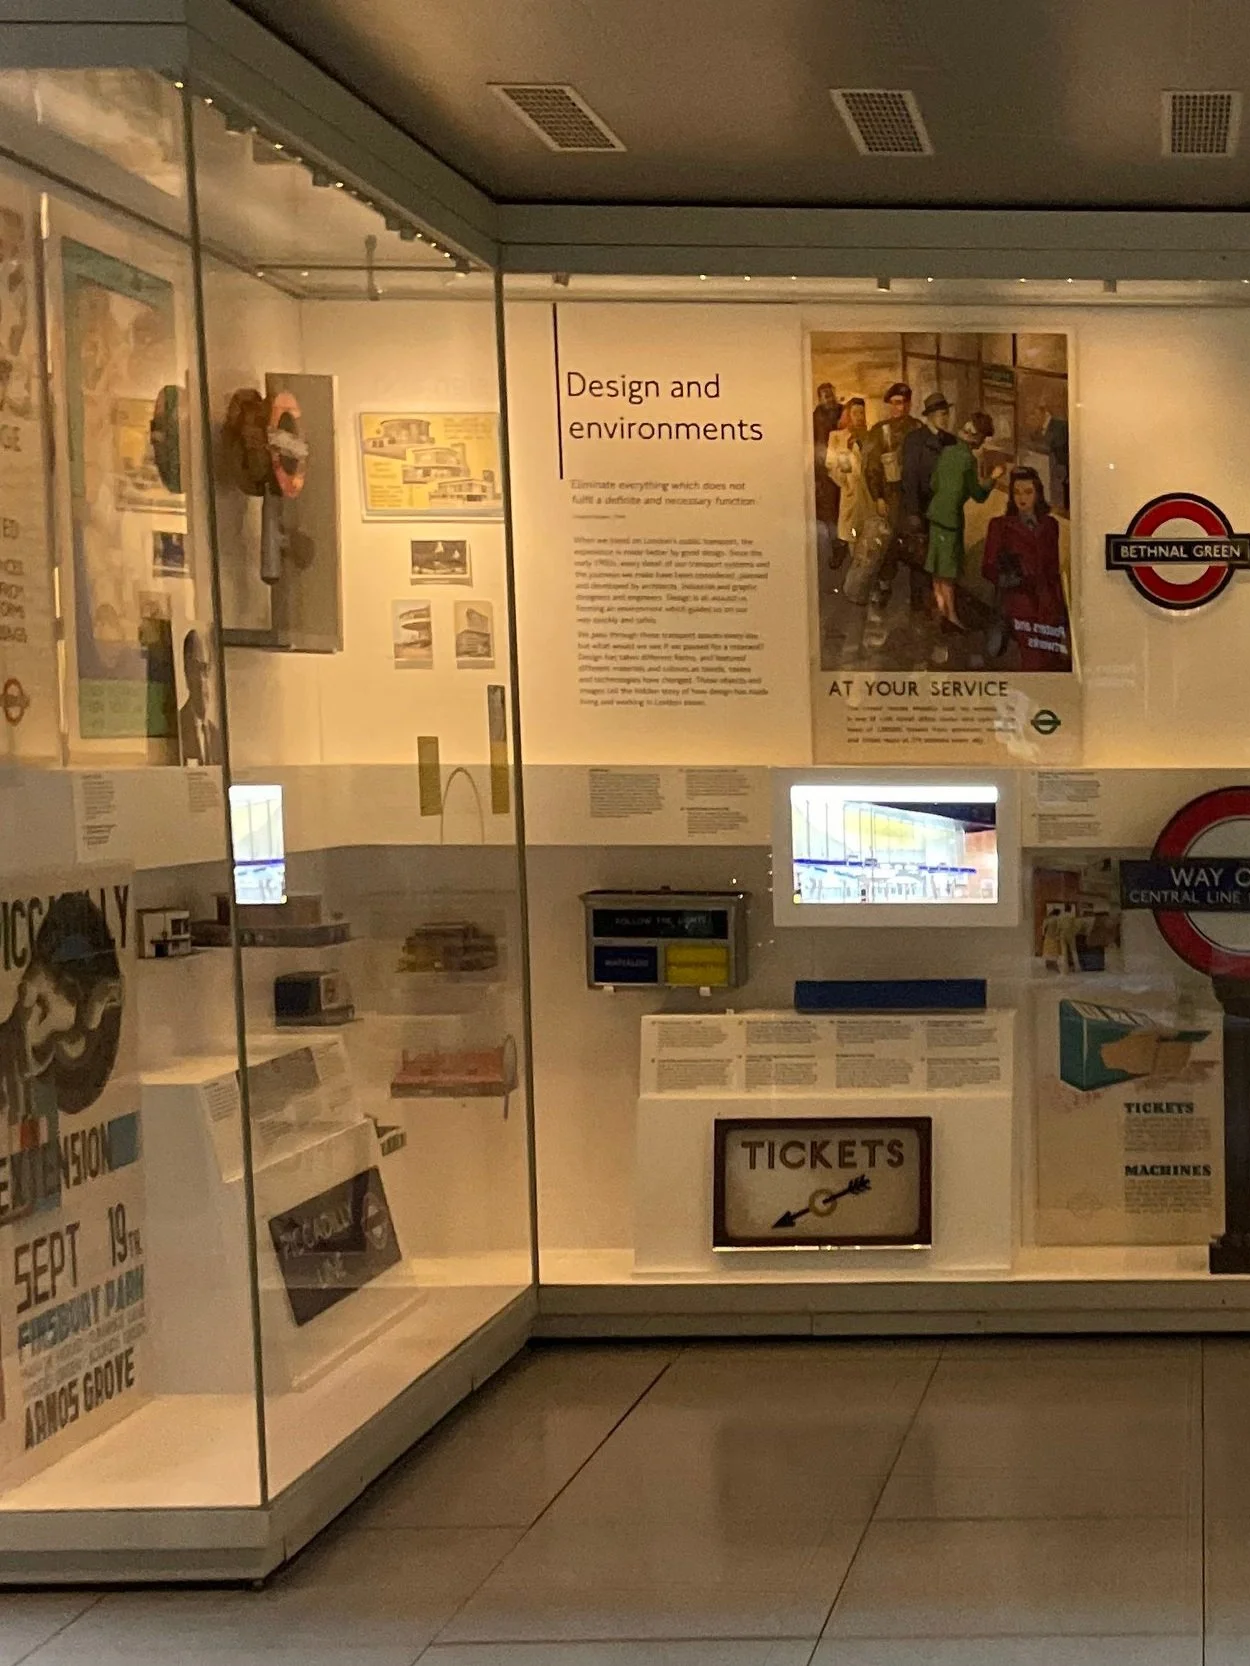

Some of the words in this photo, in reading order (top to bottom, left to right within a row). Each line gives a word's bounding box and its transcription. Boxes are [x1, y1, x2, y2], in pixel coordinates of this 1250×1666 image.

[566, 371, 660, 405] Design
[670, 374, 720, 398] and
[568, 417, 763, 441] environments
[1120, 545, 1188, 559] BETHNAL
[1193, 545, 1241, 558] GREEN
[829, 682, 852, 697] AT
[865, 681, 918, 697] YOUR
[931, 681, 1009, 698] SERVICE
[1170, 868, 1224, 888] WAY
[1129, 890, 1198, 904] CENTRAL
[1207, 891, 1241, 904] LINE
[1124, 1102, 1194, 1114] TICKETS
[741, 1140, 905, 1171] TICKETS
[1125, 1164, 1211, 1177] MACHINES
[14, 1222, 81, 1314] SEPT
[24, 1378, 80, 1451] ARNOS
[83, 1347, 135, 1414] GROVE
